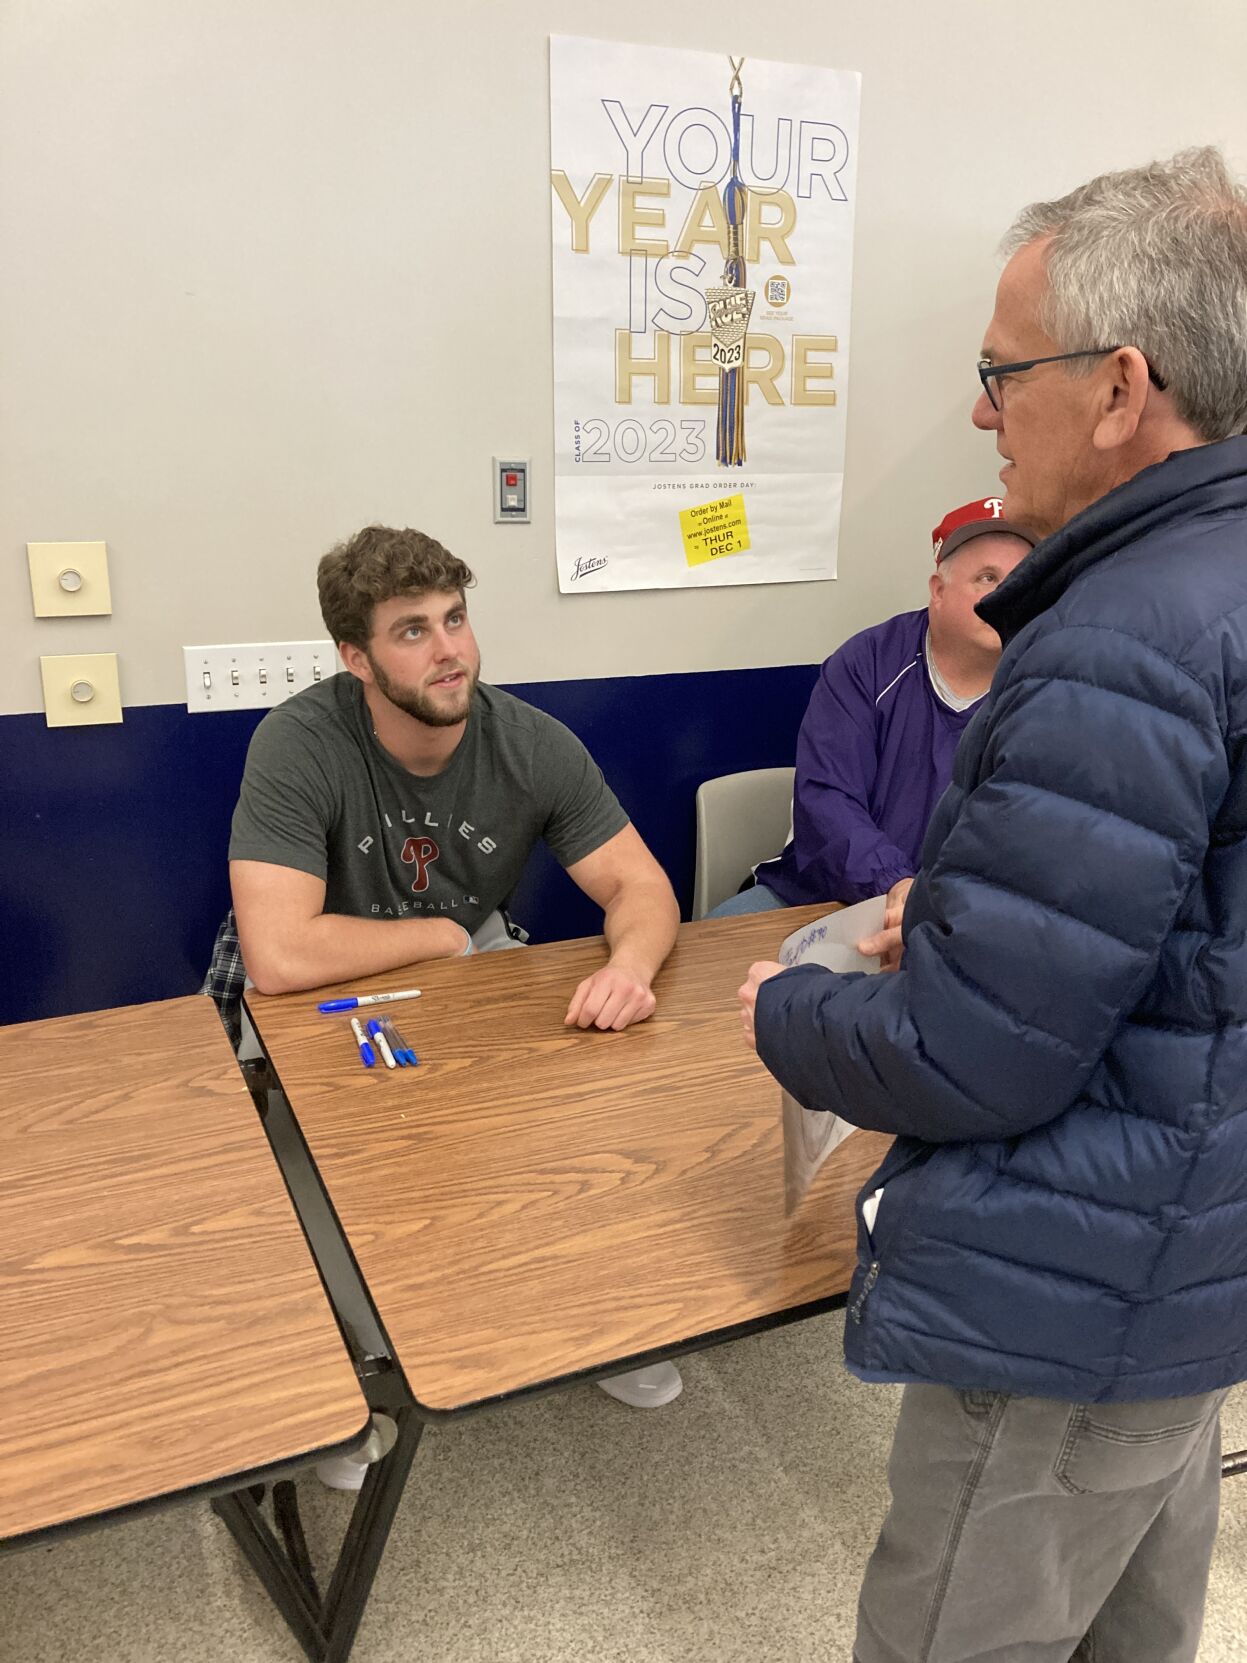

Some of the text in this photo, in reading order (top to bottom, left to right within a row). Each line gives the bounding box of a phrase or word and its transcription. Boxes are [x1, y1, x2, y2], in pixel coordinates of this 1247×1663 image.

[601, 98, 849, 202] YOUR
[551, 168, 798, 266] YEAR
[629, 248, 708, 336] IS
[713, 343, 741, 364] 2023
[614, 328, 838, 406] HERE
[574, 419, 581, 433] OF
[581, 418, 707, 464] 2023
[652, 482, 687, 490] JOSTENS
[690, 499, 732, 518] Order by Mail
[687, 518, 742, 540] www.jostens.com
[702, 514, 724, 525] Online
[702, 530, 734, 547] THUR
[710, 542, 734, 556] DEC
[736, 539, 742, 549] 1
[570, 556, 609, 582] Jostens
